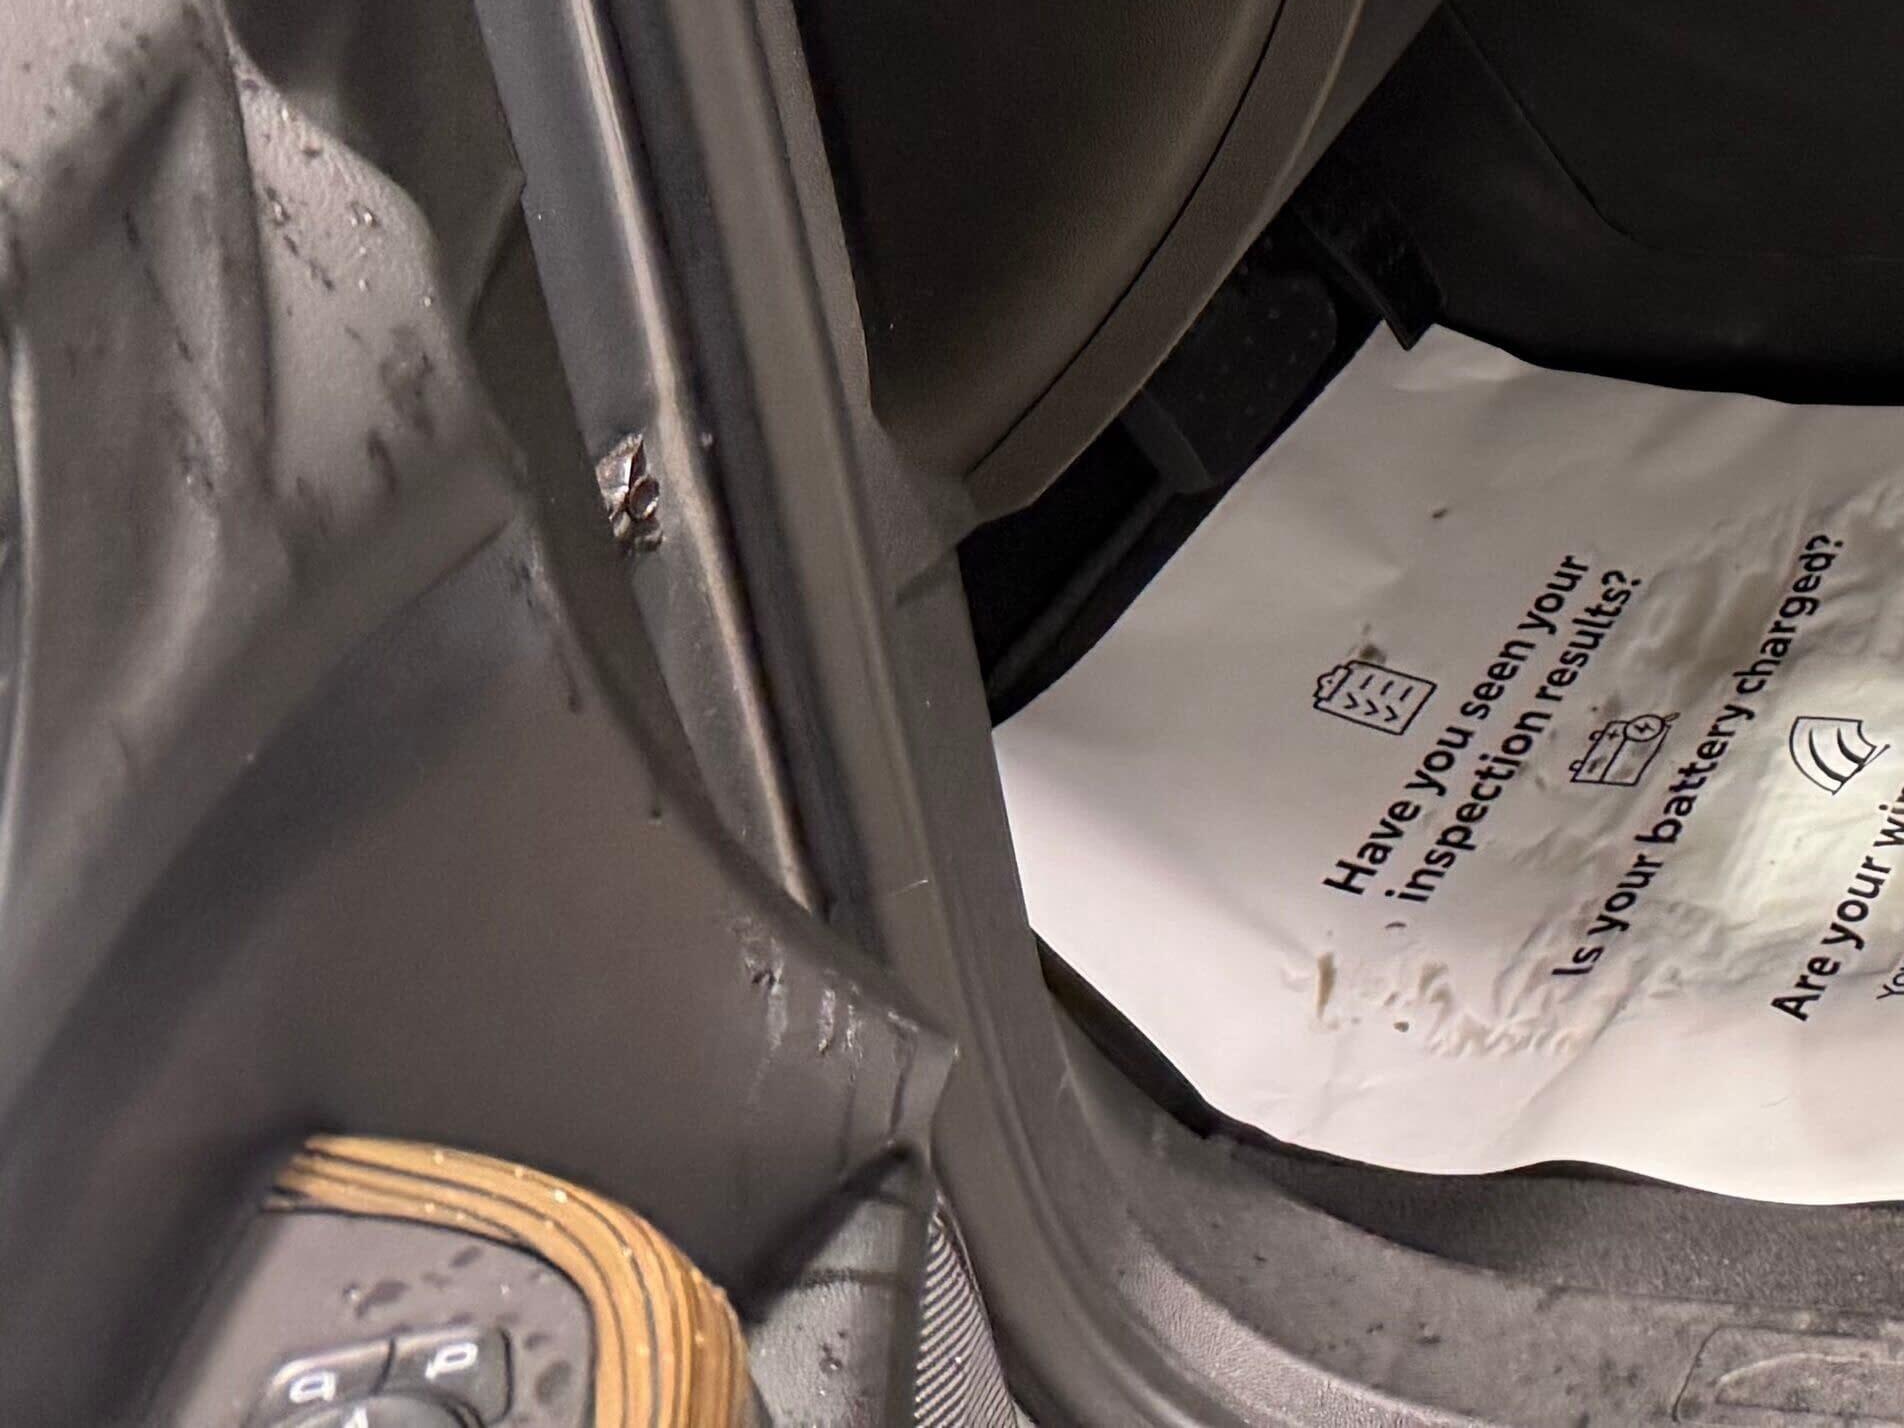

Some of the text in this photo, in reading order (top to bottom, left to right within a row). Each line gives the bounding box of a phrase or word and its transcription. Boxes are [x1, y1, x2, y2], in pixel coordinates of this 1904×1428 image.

[1322, 554, 1589, 896] Have you seen your
[1384, 570, 1643, 903] inspection results?
[1552, 534, 1844, 976] Is your battery charged?
[1770, 955, 1841, 1022] Are
[1820, 855, 1891, 951] your
